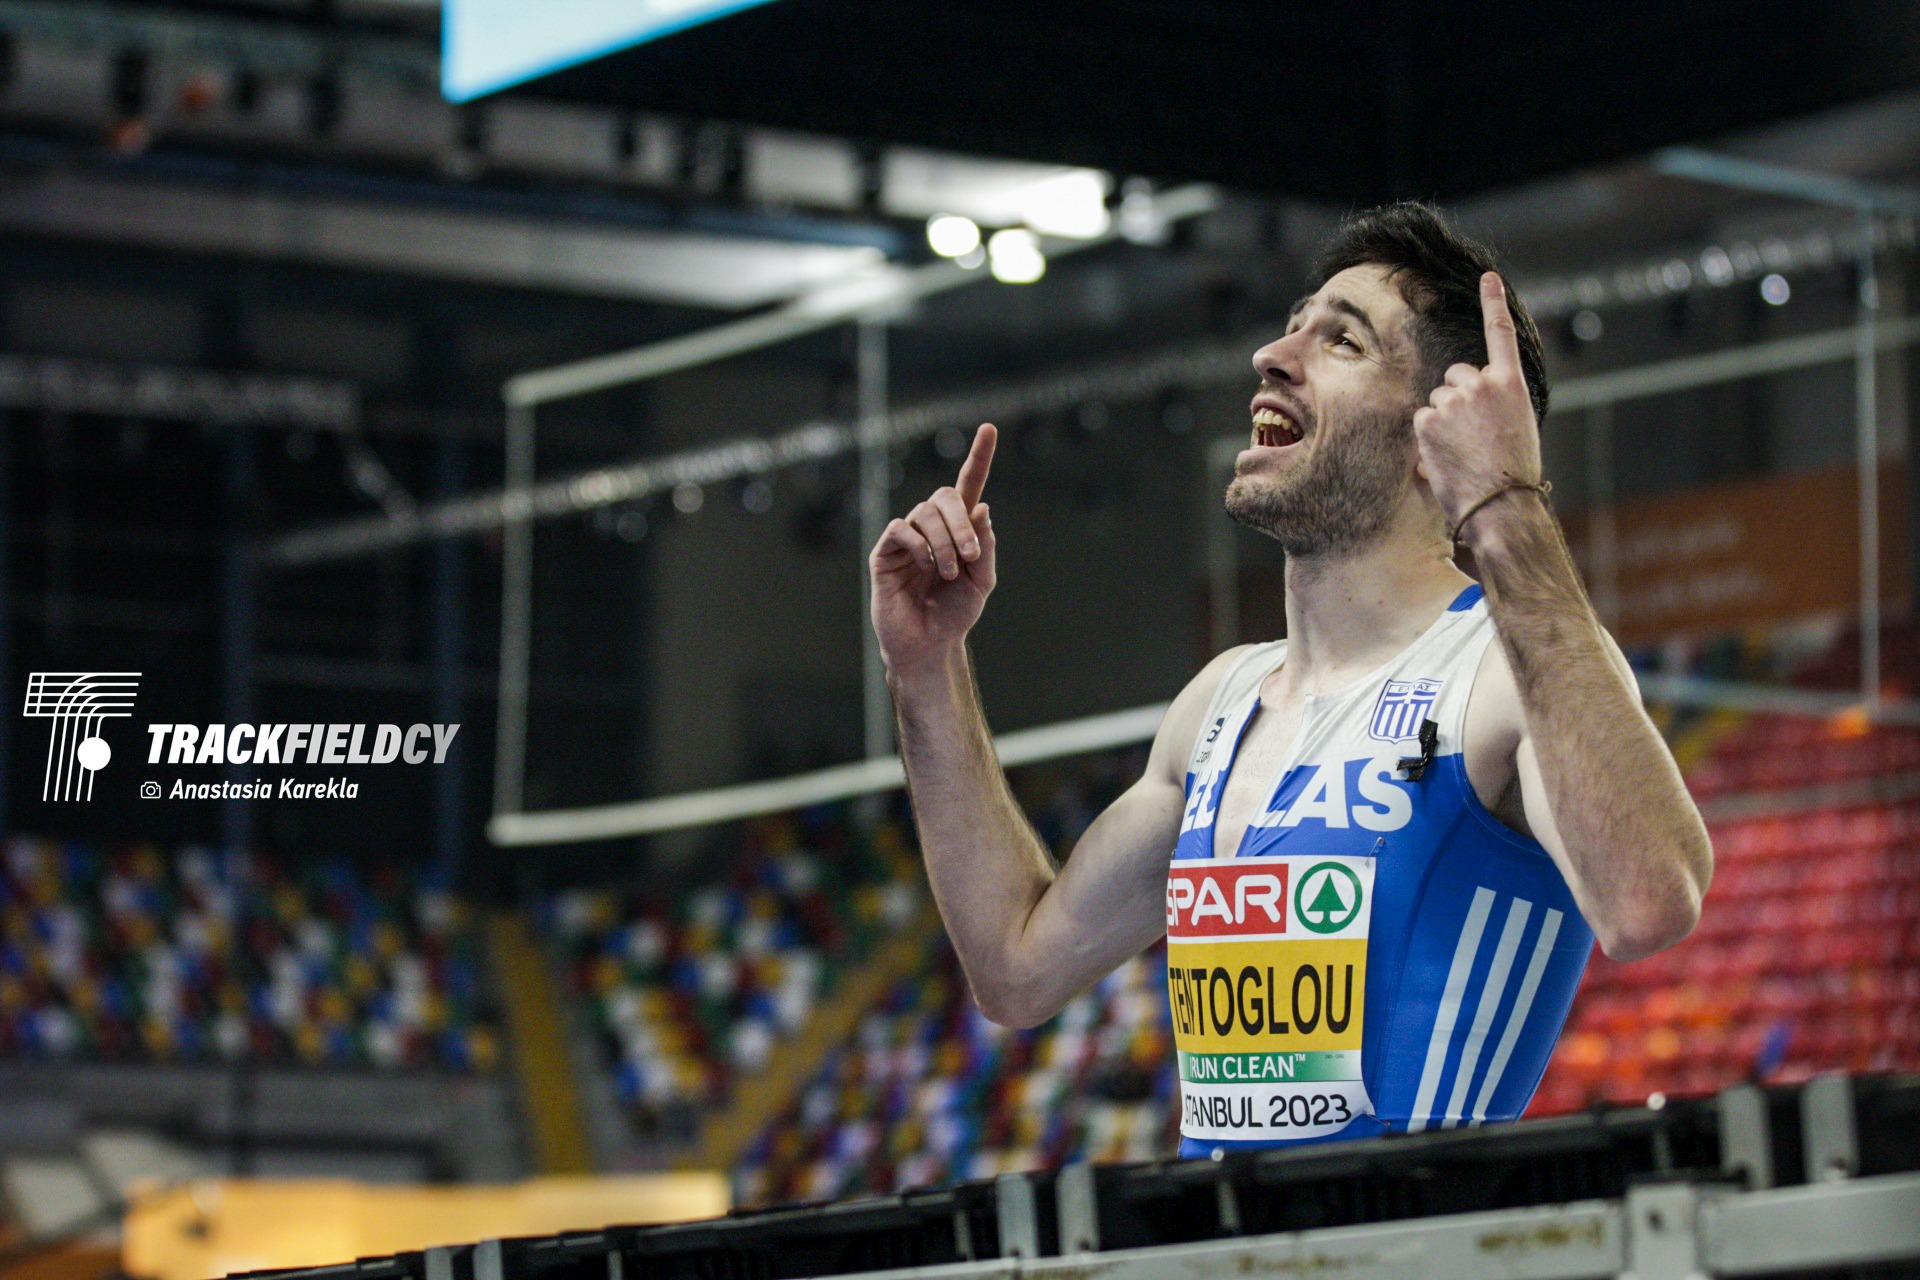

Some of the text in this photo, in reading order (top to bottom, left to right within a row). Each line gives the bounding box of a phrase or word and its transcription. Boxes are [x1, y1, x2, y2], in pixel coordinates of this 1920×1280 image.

[1166, 874, 1282, 926] SPAR
[1169, 963, 1354, 1037] TENTOGLOU
[1185, 1094, 1352, 1128] STANBUL 2023
